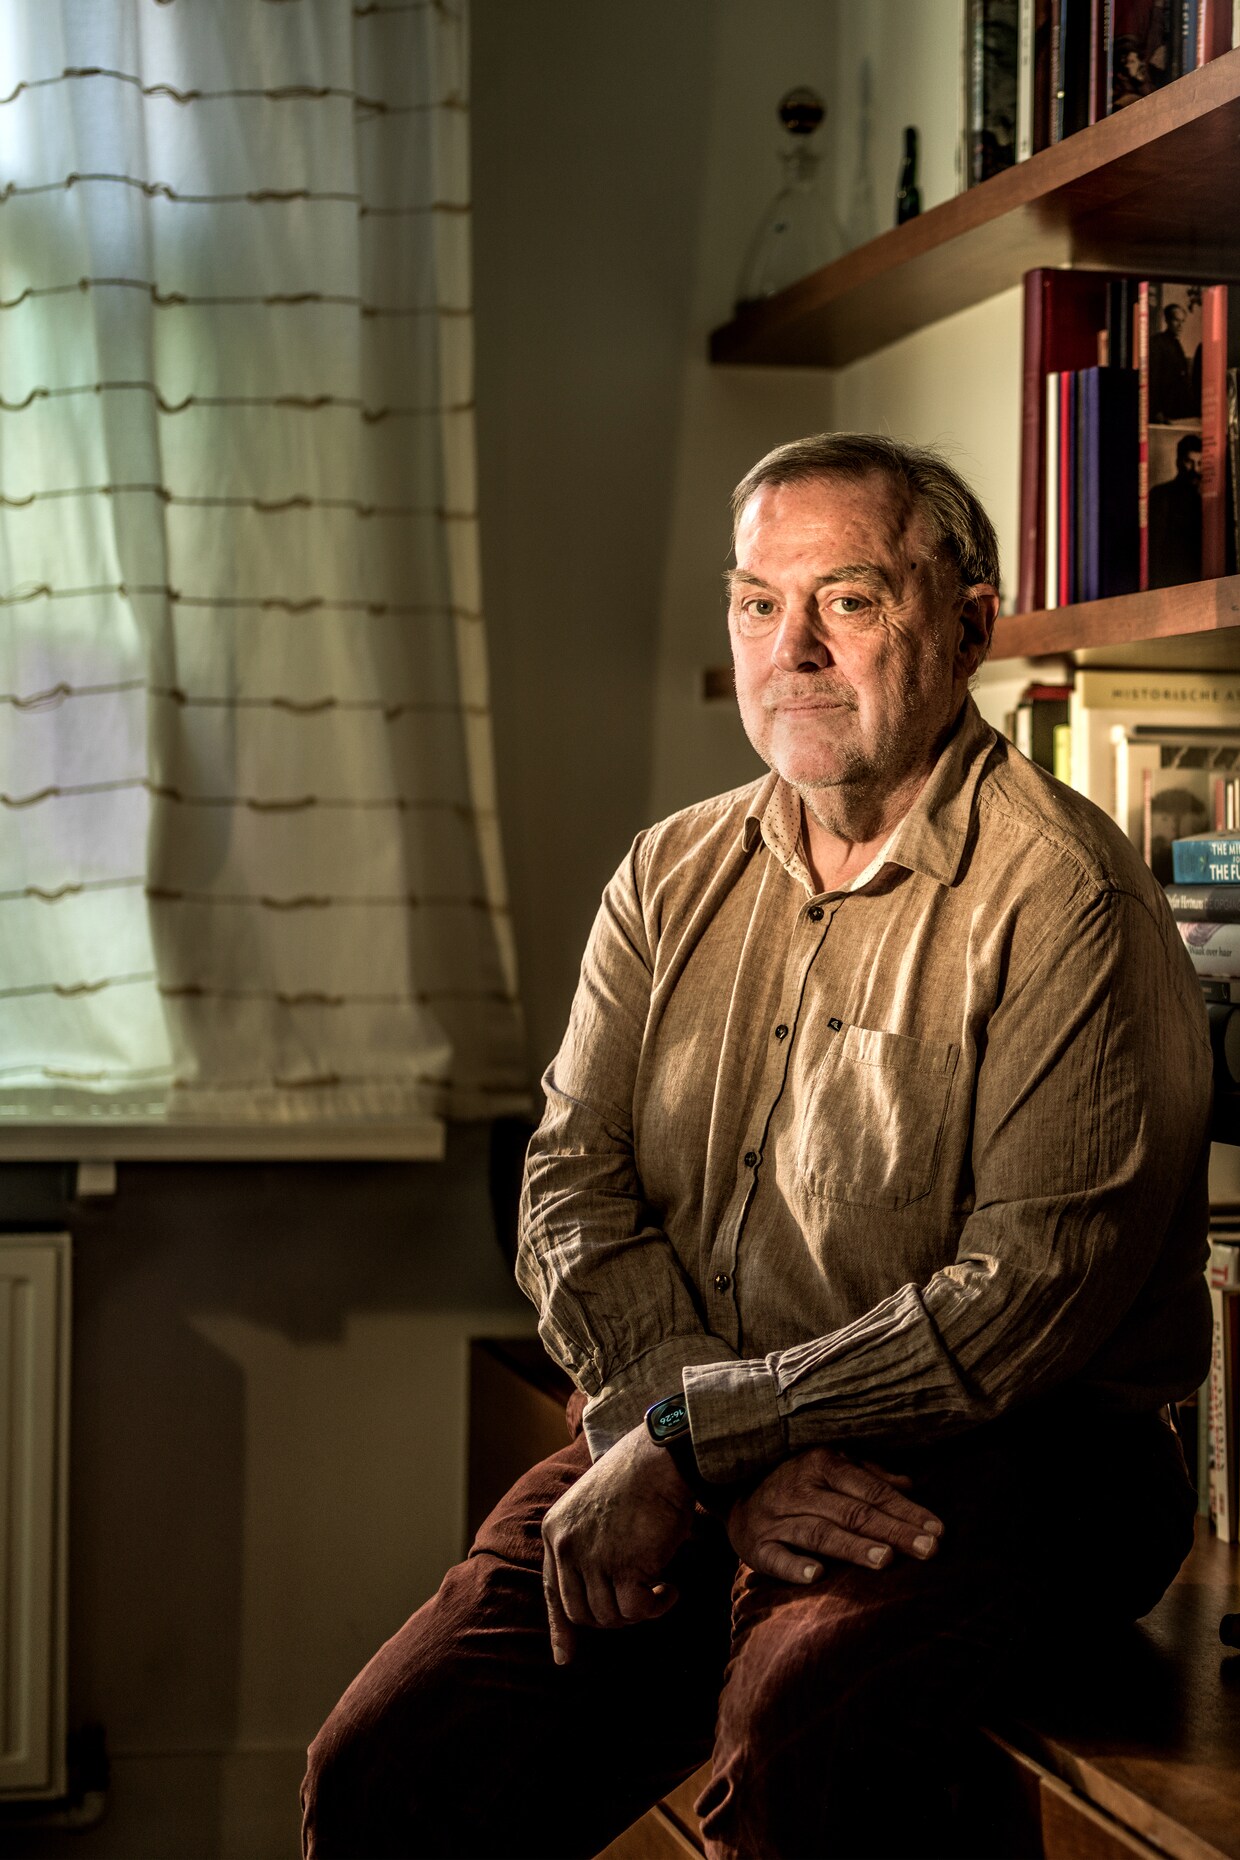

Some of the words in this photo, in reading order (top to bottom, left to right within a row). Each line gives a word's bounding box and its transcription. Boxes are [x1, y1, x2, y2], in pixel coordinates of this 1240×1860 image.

[1112, 688, 1220, 701] HISTORISCHE
[1211, 843, 1227, 856] THE
[1209, 864, 1230, 880] THE
[1219, 946, 1232, 957] haar
[659, 1408, 685, 1425] 16:26
